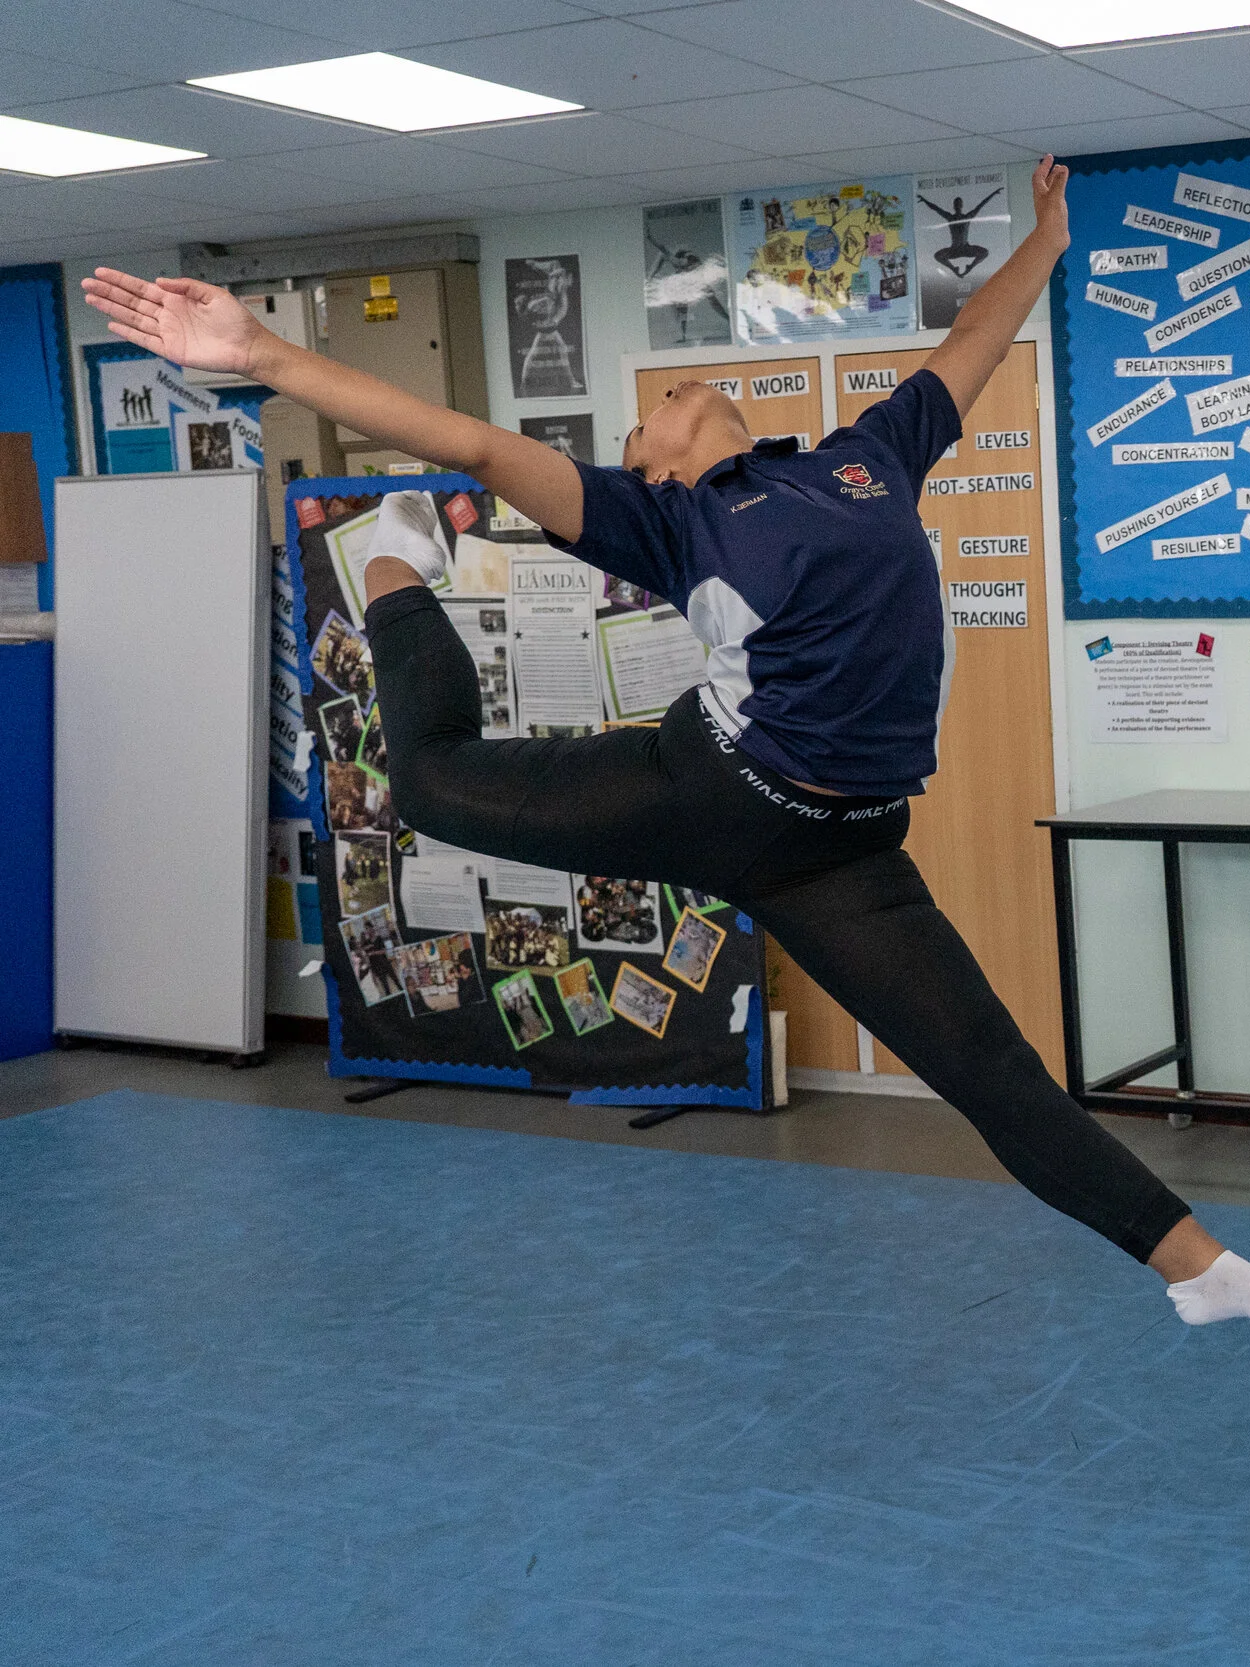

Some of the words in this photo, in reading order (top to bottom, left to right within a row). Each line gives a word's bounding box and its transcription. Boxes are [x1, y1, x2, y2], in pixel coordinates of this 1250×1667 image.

[1133, 211, 1213, 243] LEADERSHIP
[1100, 252, 1158, 269] PATHY
[1095, 288, 1150, 315] HUMOUR
[1154, 294, 1234, 342] CONFIDENCE
[1125, 359, 1225, 373] RELATIONSHIPS
[156, 370, 212, 413] Movement
[752, 374, 806, 397] WORD
[848, 371, 896, 391] WALL
[1096, 388, 1168, 439] ENDURANCE
[1200, 408, 1236, 429] BODY
[977, 432, 1029, 449] LEVELS
[1121, 446, 1229, 463] CONCENTRATION
[928, 479, 965, 496] HOT-
[968, 473, 1033, 493] SEATING
[1104, 513, 1157, 546] PUSHING
[1157, 482, 1221, 521] YOURSELF
[961, 538, 1028, 556] GESTURE
[1160, 537, 1236, 556] RESILIENCE
[950, 583, 1025, 598] THOUGHT
[951, 611, 1027, 627] TRACKING
[842, 806, 884, 822] NIKE
